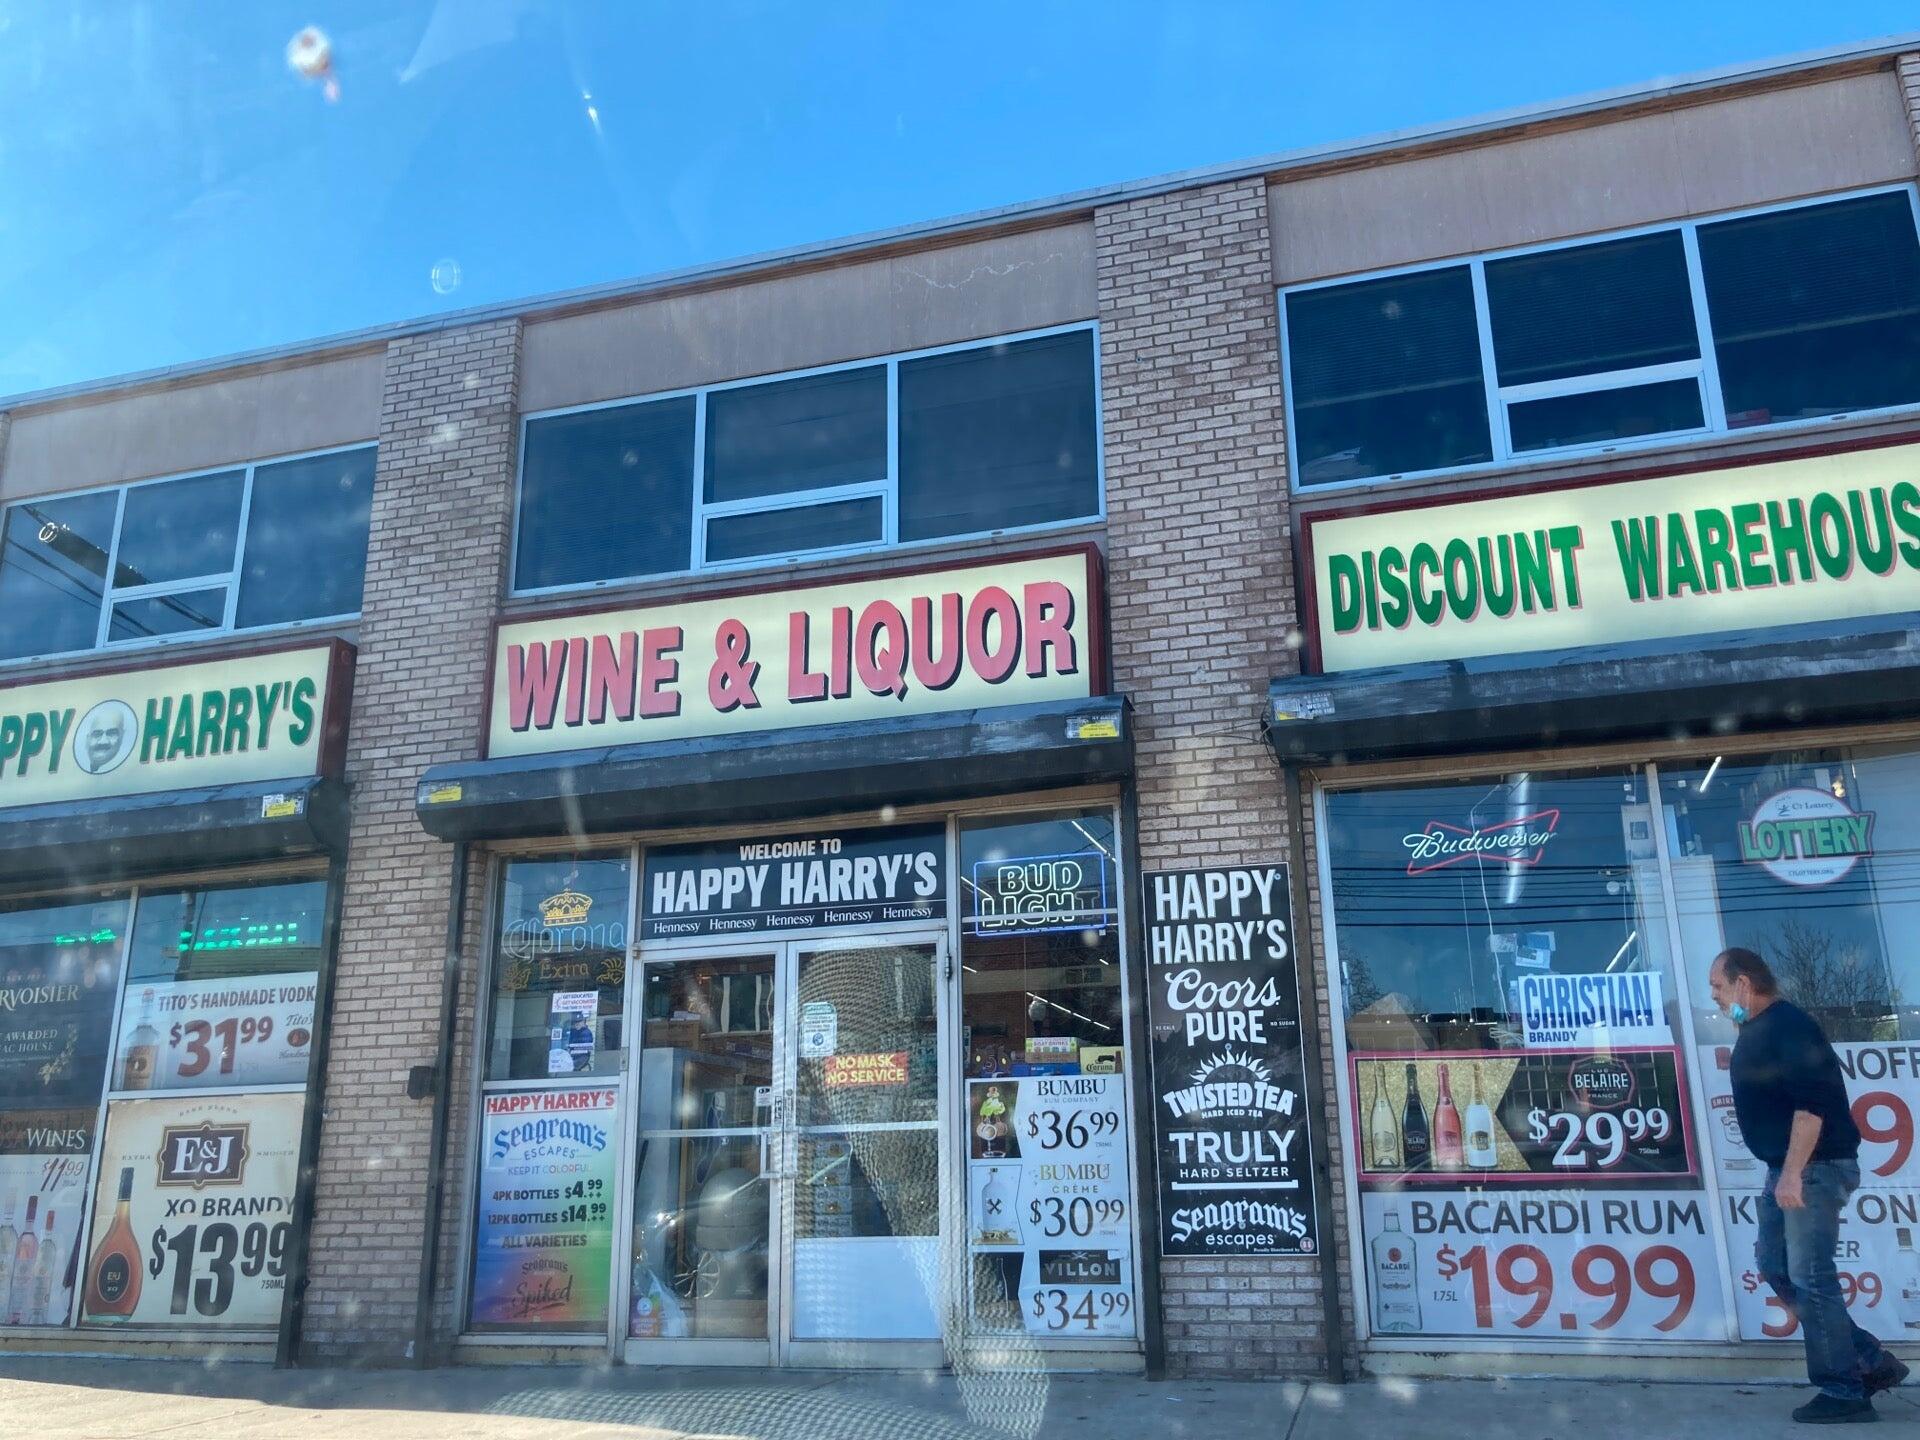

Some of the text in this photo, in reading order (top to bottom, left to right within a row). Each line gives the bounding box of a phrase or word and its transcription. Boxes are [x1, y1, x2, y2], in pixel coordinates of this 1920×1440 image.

[1328, 481, 1920, 634] DISCOUNT WAREHOUS
[507, 581, 1079, 732] WINE & LIQUOR
[139, 676, 317, 764] HARRY'S
[740, 838, 842, 861] WELCOME TO
[1403, 829, 1558, 859] Budweiser
[1741, 814, 1869, 860] LOTTERY
[652, 851, 937, 914] HAPPY HARRY'S
[998, 860, 1082, 895] BUD
[981, 890, 1100, 928] LIGHT
[1154, 869, 1276, 921] HAPPY
[654, 905, 933, 934] Hennessy Hennessy Hennessy Hennessy Hennessy
[502, 918, 627, 963] Corona
[1151, 918, 1288, 965] HARRY'S
[538, 958, 590, 980] Extra
[159, 985, 316, 1012] TITO'S HANDMADE VODK
[1164, 968, 1281, 1011] Coors
[1524, 975, 1654, 1030] CHRISTIAN
[285, 1013, 313, 1027] Tito's
[1186, 1010, 1267, 1046] PURE
[5, 1029, 58, 1041] AWARDED
[1529, 1031, 1577, 1043] BRANDY
[826, 1068, 905, 1084] NO SERVICE
[836, 1054, 897, 1069] NO MASK
[1037, 1078, 1107, 1096] BUMBU
[1574, 1072, 1629, 1088] BELAIRE
[487, 1090, 615, 1113] HAPPY HARRY'S
[1163, 1081, 1295, 1118] TWISTED TEA
[1202, 1110, 1224, 1119] HARD
[1248, 1110, 1263, 1118] TEA
[26, 1128, 86, 1149] WINES
[493, 1118, 608, 1158] Seagram's
[524, 1145, 576, 1160] ESCAPES
[1169, 1129, 1296, 1163] TRULY
[171, 1136, 235, 1174] E&J
[508, 1165, 530, 1176] KEEP
[531, 1165, 540, 1175] IT
[1040, 1163, 1110, 1180] BUMBU
[1180, 1167, 1289, 1178] HARD SELTZER
[165, 1197, 296, 1217] XO BRANDY
[493, 1190, 512, 1201] 4PK
[513, 1189, 559, 1200] BOTTLES
[488, 1214, 512, 1226] 12PK
[512, 1213, 558, 1224] BOTTLES
[1171, 1200, 1308, 1242] Seagram's
[1411, 1200, 1592, 1235] BACARDI
[1603, 1199, 1706, 1235] RUM
[502, 1234, 588, 1249] ALL VARIETIES
[1044, 1262, 1117, 1277] VILLON
[513, 1274, 574, 1318] Spiked
[1436, 1243, 1696, 1333] $19.99
